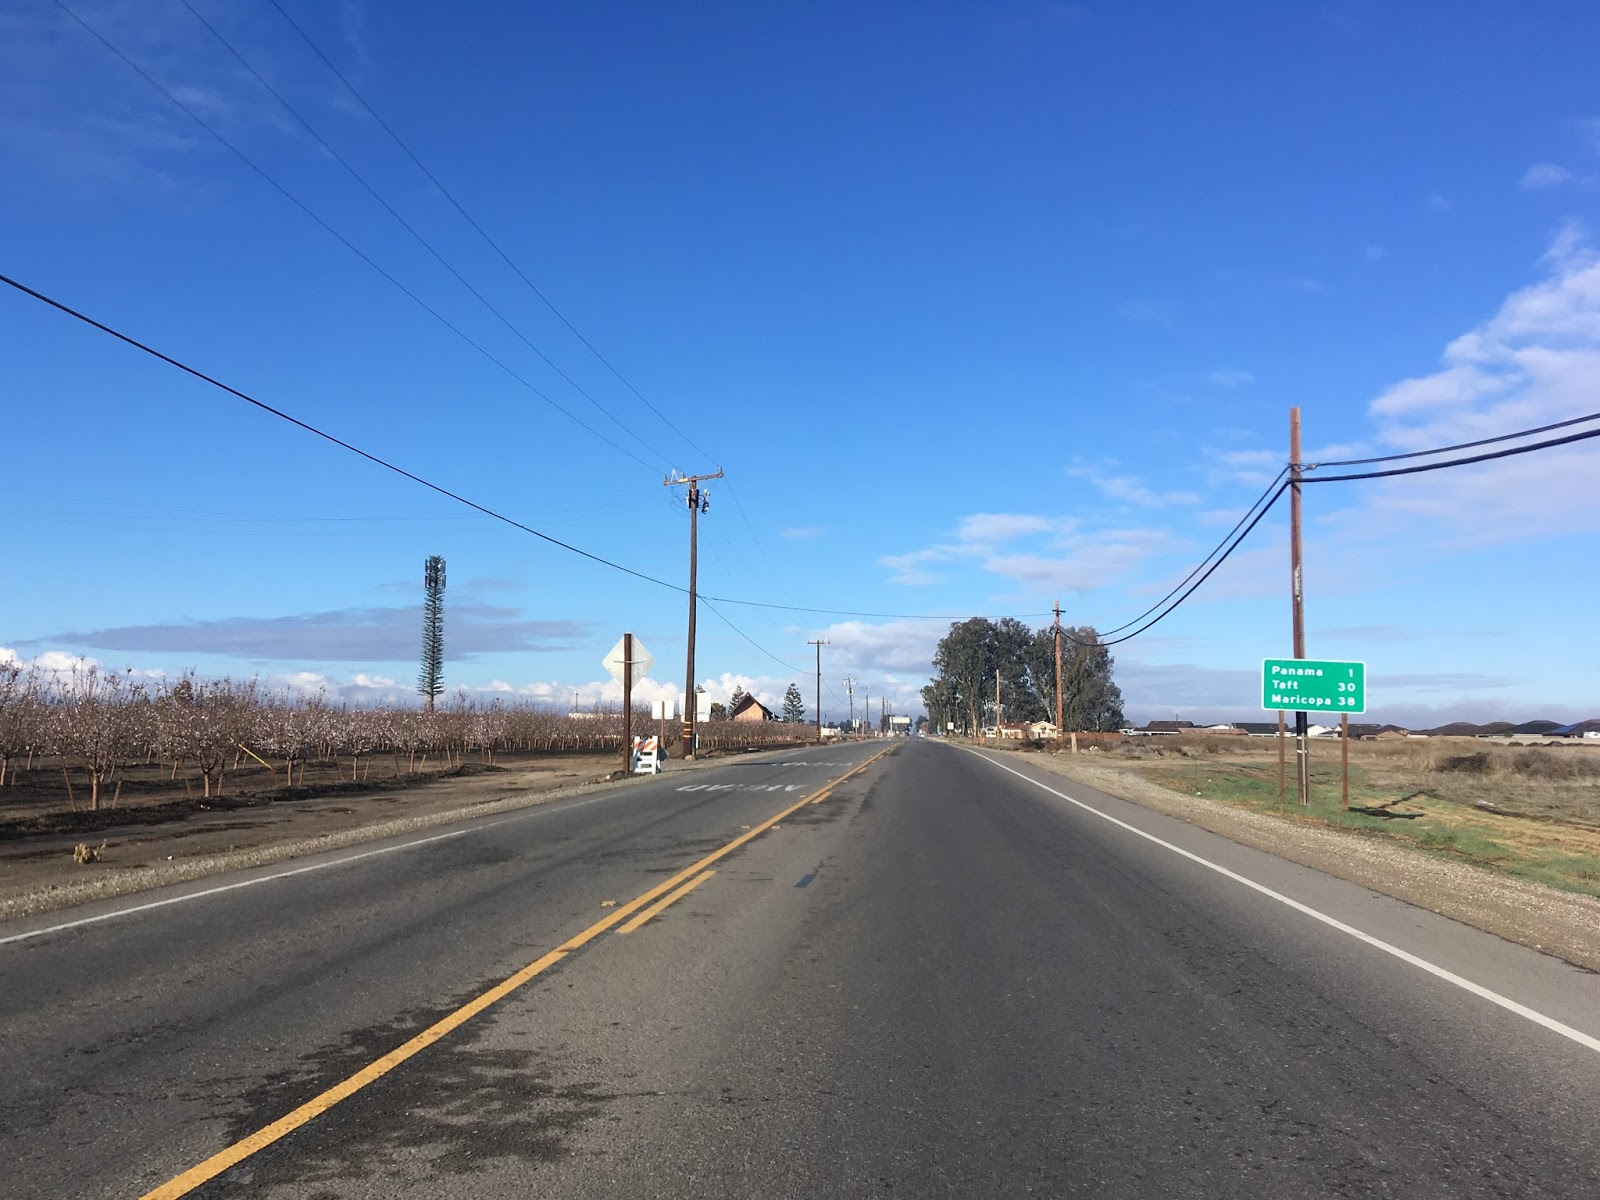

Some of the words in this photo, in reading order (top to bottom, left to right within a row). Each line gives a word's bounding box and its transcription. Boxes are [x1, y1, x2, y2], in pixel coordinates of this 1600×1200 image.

[1272, 665, 1323, 676] Panama
[1348, 668, 1354, 678] 1
[1272, 680, 1298, 689] Taft
[1338, 682, 1356, 691] 30
[1271, 694, 1331, 706] Maricopa
[1338, 696, 1355, 706] 38
